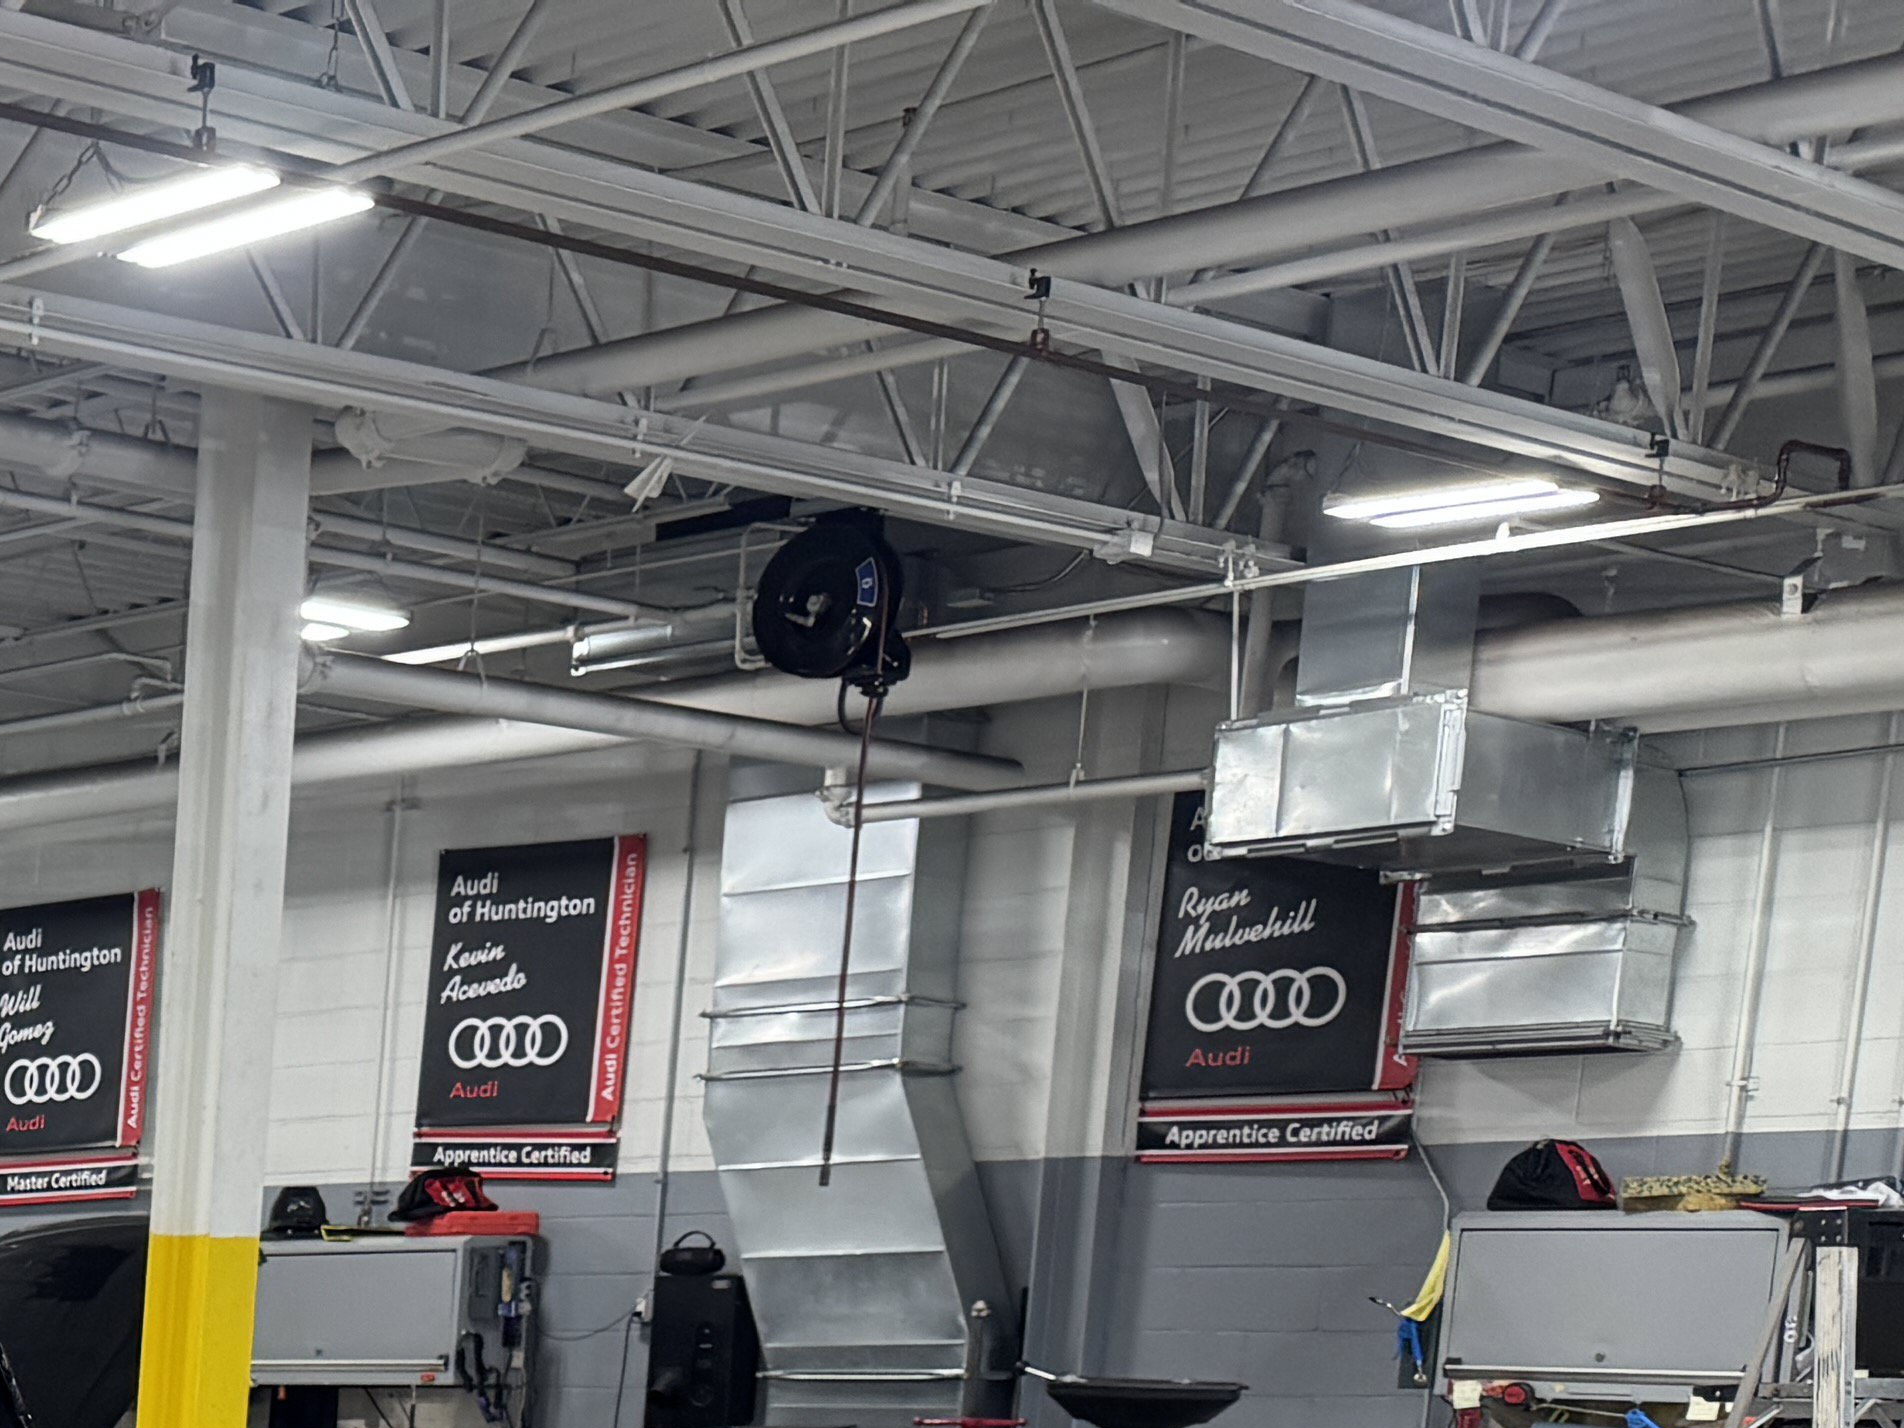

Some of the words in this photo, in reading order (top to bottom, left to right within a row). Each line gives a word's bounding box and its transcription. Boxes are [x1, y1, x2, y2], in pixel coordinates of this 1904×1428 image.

[450, 872, 499, 897] Audi
[448, 902, 473, 925] of
[475, 896, 596, 924] Huntington
[615, 852, 638, 960] Technician
[1177, 886, 1251, 924] Ryan
[2, 928, 43, 952] Audi
[1173, 898, 1318, 959] Mulvehill
[1, 955, 23, 976] of
[24, 946, 123, 975] Huntington
[136, 905, 154, 1002] Technician
[442, 941, 506, 972] Kevin
[439, 963, 528, 1005] Acevedo
[605, 963, 629, 1050] Certified
[130, 1003, 147, 1089] Certified
[1185, 1046, 1251, 1068] Audi
[449, 1080, 499, 1099] Audi
[600, 1055, 617, 1101] Audi
[5, 1114, 46, 1132] Audi
[126, 1087, 139, 1129] Audi
[1164, 1125, 1280, 1149] Apprentice
[1284, 1120, 1379, 1142] Certified
[432, 1146, 518, 1168] Apprentice
[521, 1145, 592, 1165] Certified
[6, 1172, 49, 1192] Master
[50, 1169, 107, 1189] Certified
